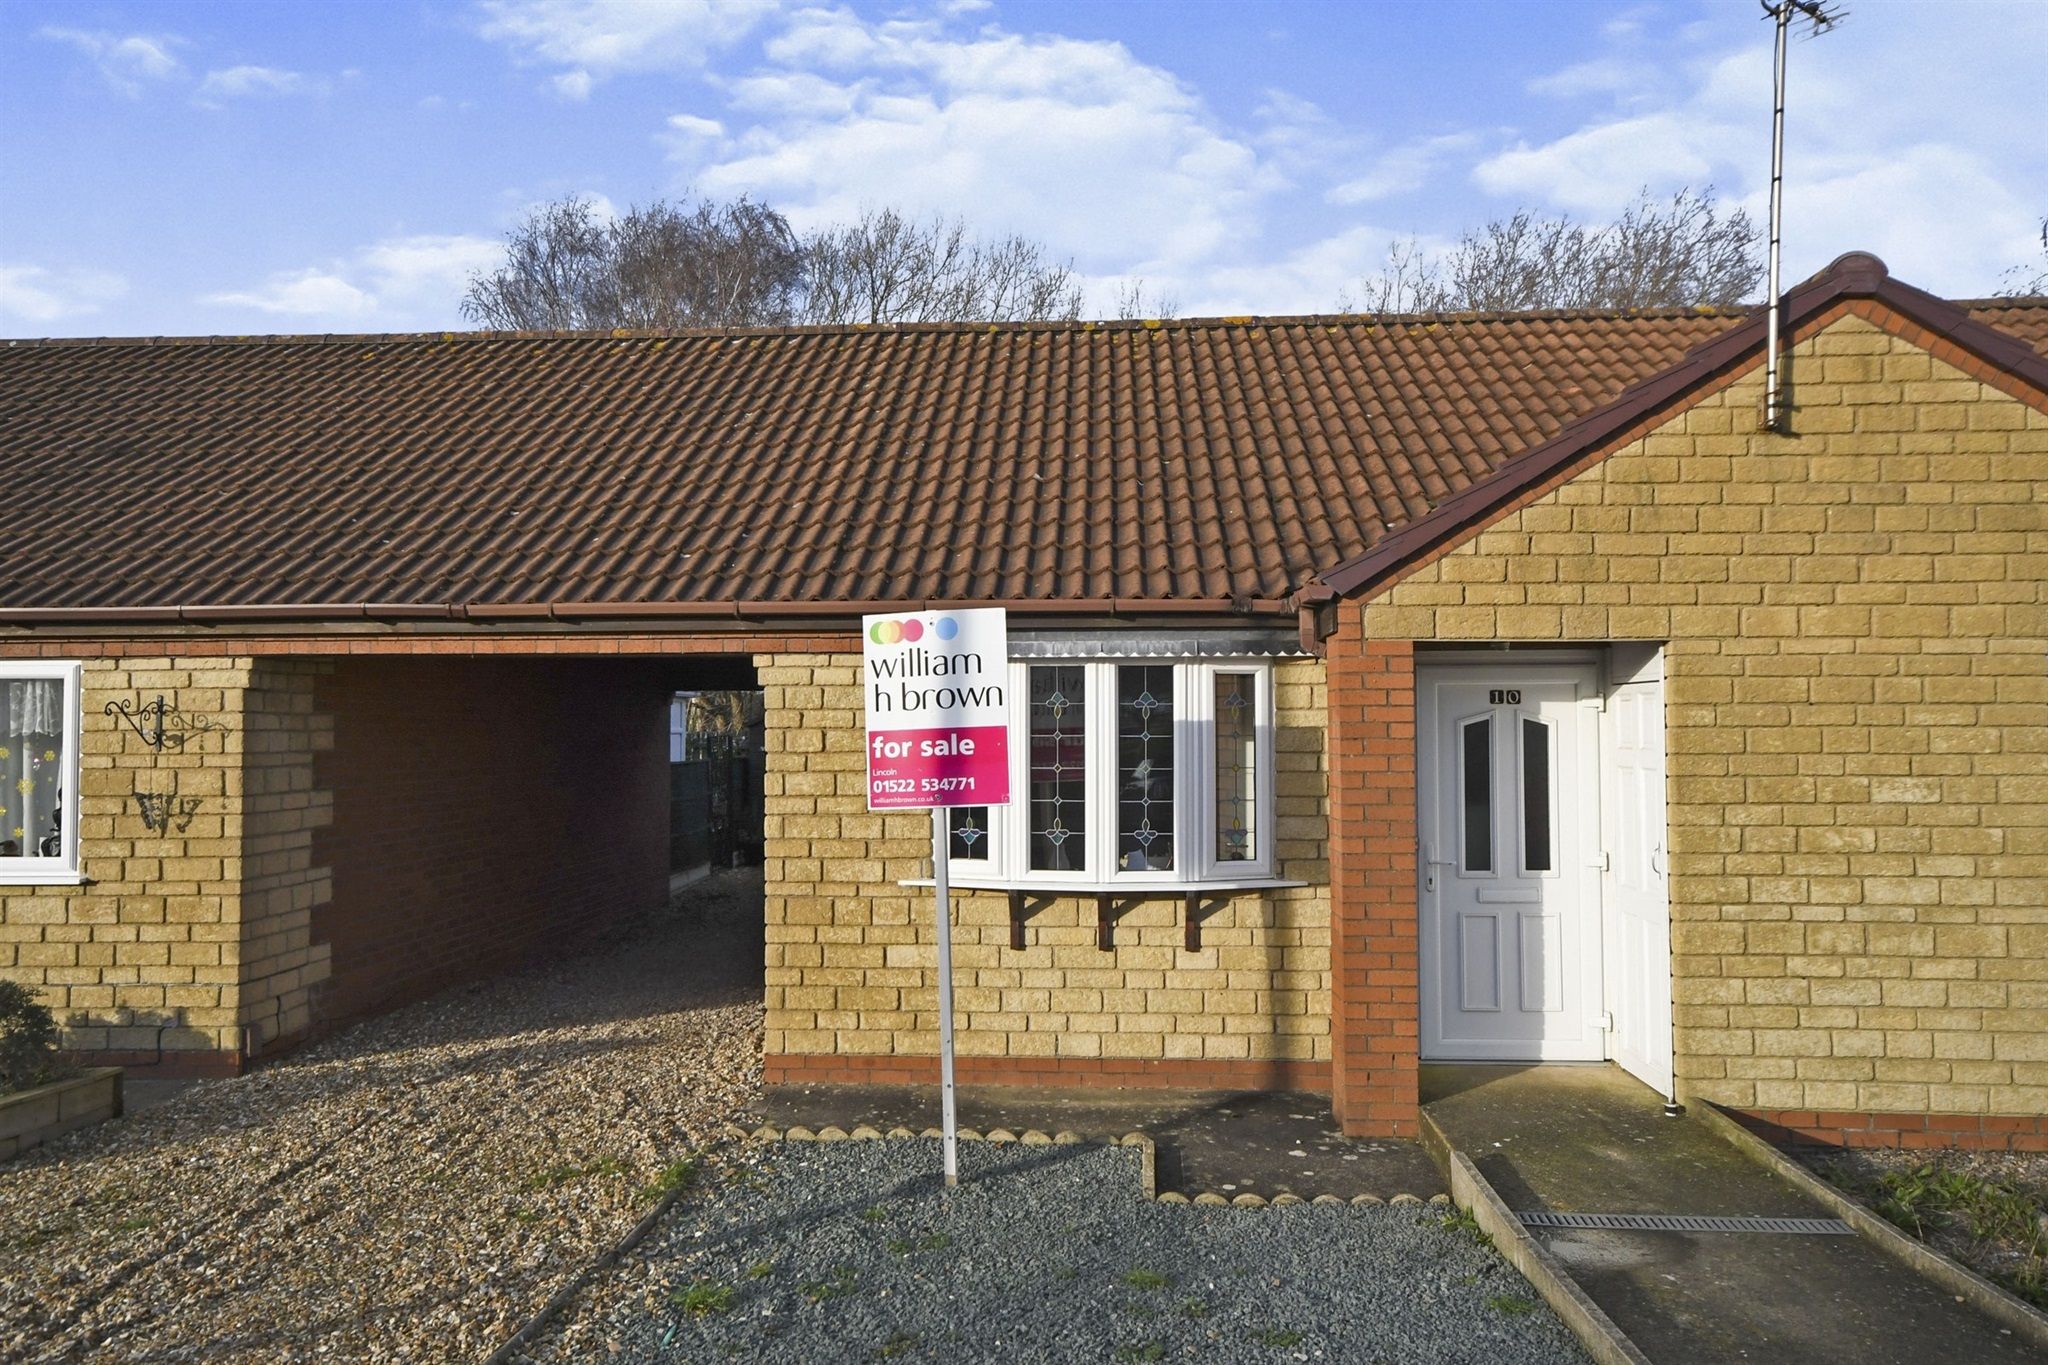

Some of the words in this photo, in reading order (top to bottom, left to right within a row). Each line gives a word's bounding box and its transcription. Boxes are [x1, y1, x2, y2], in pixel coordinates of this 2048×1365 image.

[871, 647, 982, 679] william
[875, 683, 891, 712] h
[901, 682, 1003, 711] brown
[1492, 691, 1520, 704] 10
[872, 736, 912, 758] for
[920, 733, 975, 757] sale
[872, 768, 897, 776] Lincoln
[873, 779, 915, 793] 01522
[921, 777, 975, 792] 534771
